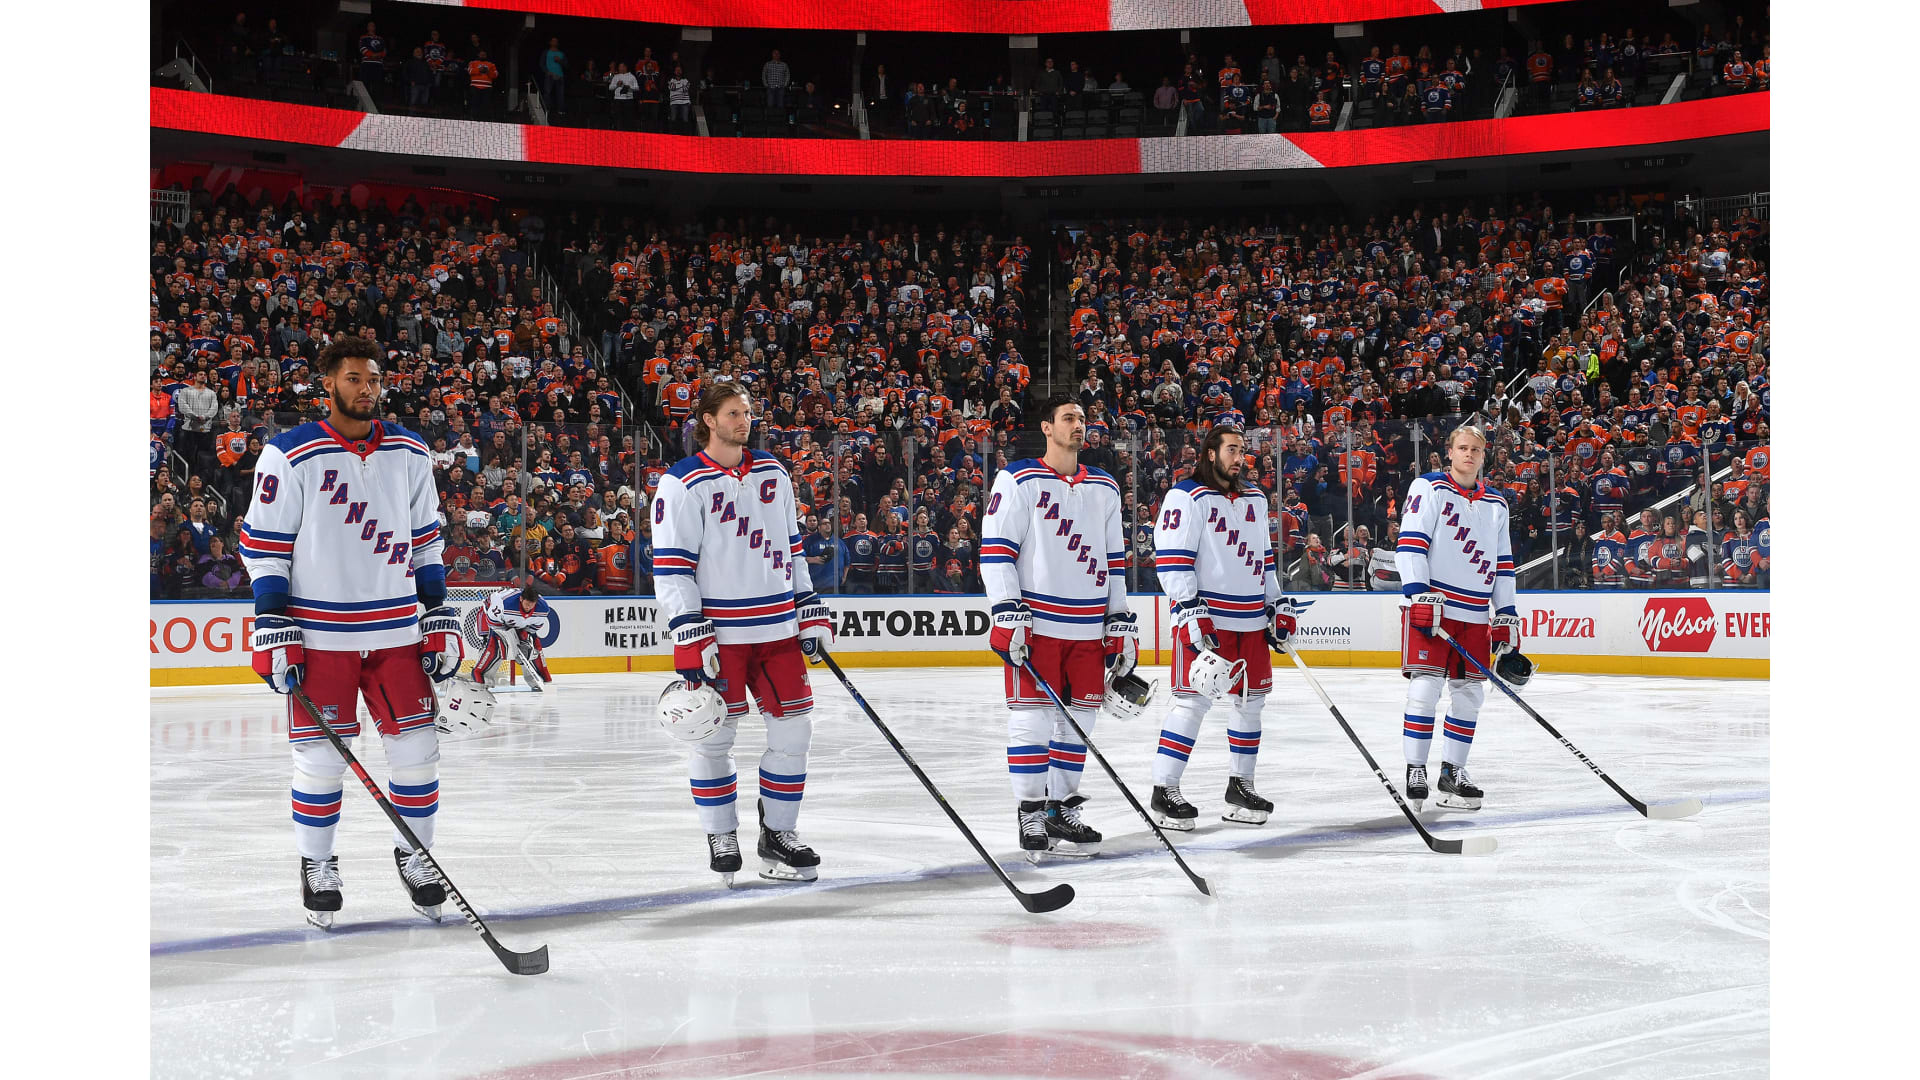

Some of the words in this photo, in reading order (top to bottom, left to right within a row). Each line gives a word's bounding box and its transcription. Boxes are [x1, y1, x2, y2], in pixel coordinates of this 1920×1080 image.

[760, 479, 777, 503] C
[984, 492, 1002, 515] 0
[320, 470, 415, 577] RANGERS
[1162, 509, 1182, 530] 93
[1245, 504, 1255, 522] A
[711, 492, 793, 580] RANGERS
[1036, 491, 1108, 587] RANGERS
[1442, 502, 1496, 585] RANGERS
[605, 606, 658, 624] HEAVY
[802, 607, 830, 619] WAR
[1531, 609, 1596, 638] Pizza
[1725, 612, 1770, 638] EVER
[604, 631, 658, 649] METAL
[1638, 607, 1719, 651] Molson
[449, 697, 462, 711] 79
[415, 847, 486, 936] WARRIOR
